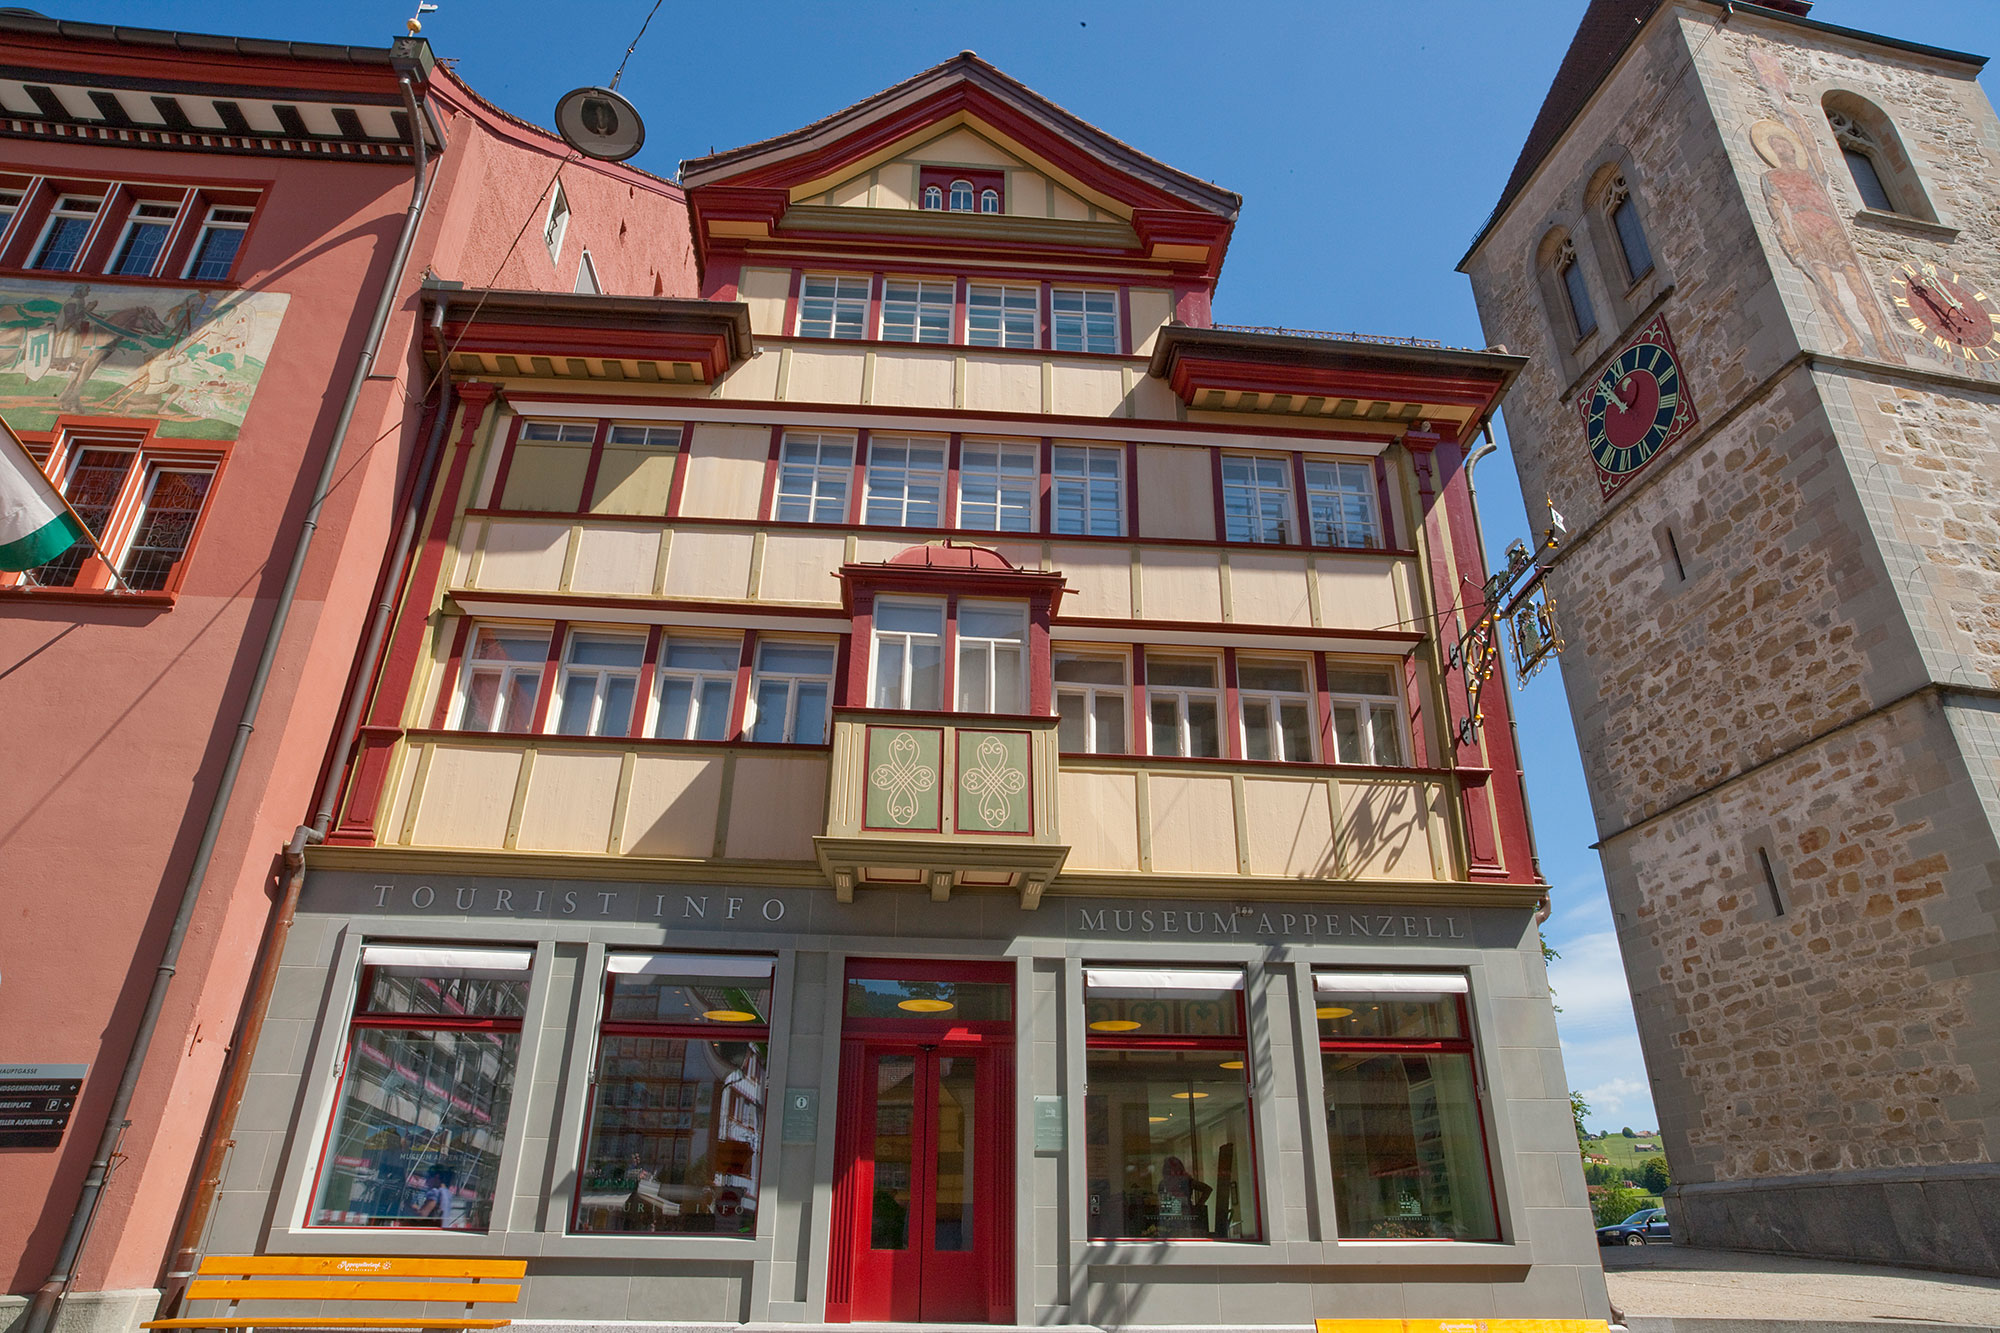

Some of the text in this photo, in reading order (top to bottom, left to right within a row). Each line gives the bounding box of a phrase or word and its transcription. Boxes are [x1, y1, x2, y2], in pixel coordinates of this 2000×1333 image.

[1634, 347, 1640, 369] I
[1647, 348, 1662, 372] II
[1609, 358, 1625, 384] XII
[1657, 364, 1676, 387] III
[1589, 410, 1605, 424] X
[1653, 423, 1669, 439] V
[373, 884, 786, 923] TOURIST INFO
[1079, 908, 1466, 940] MUSEUM APPENZELL
